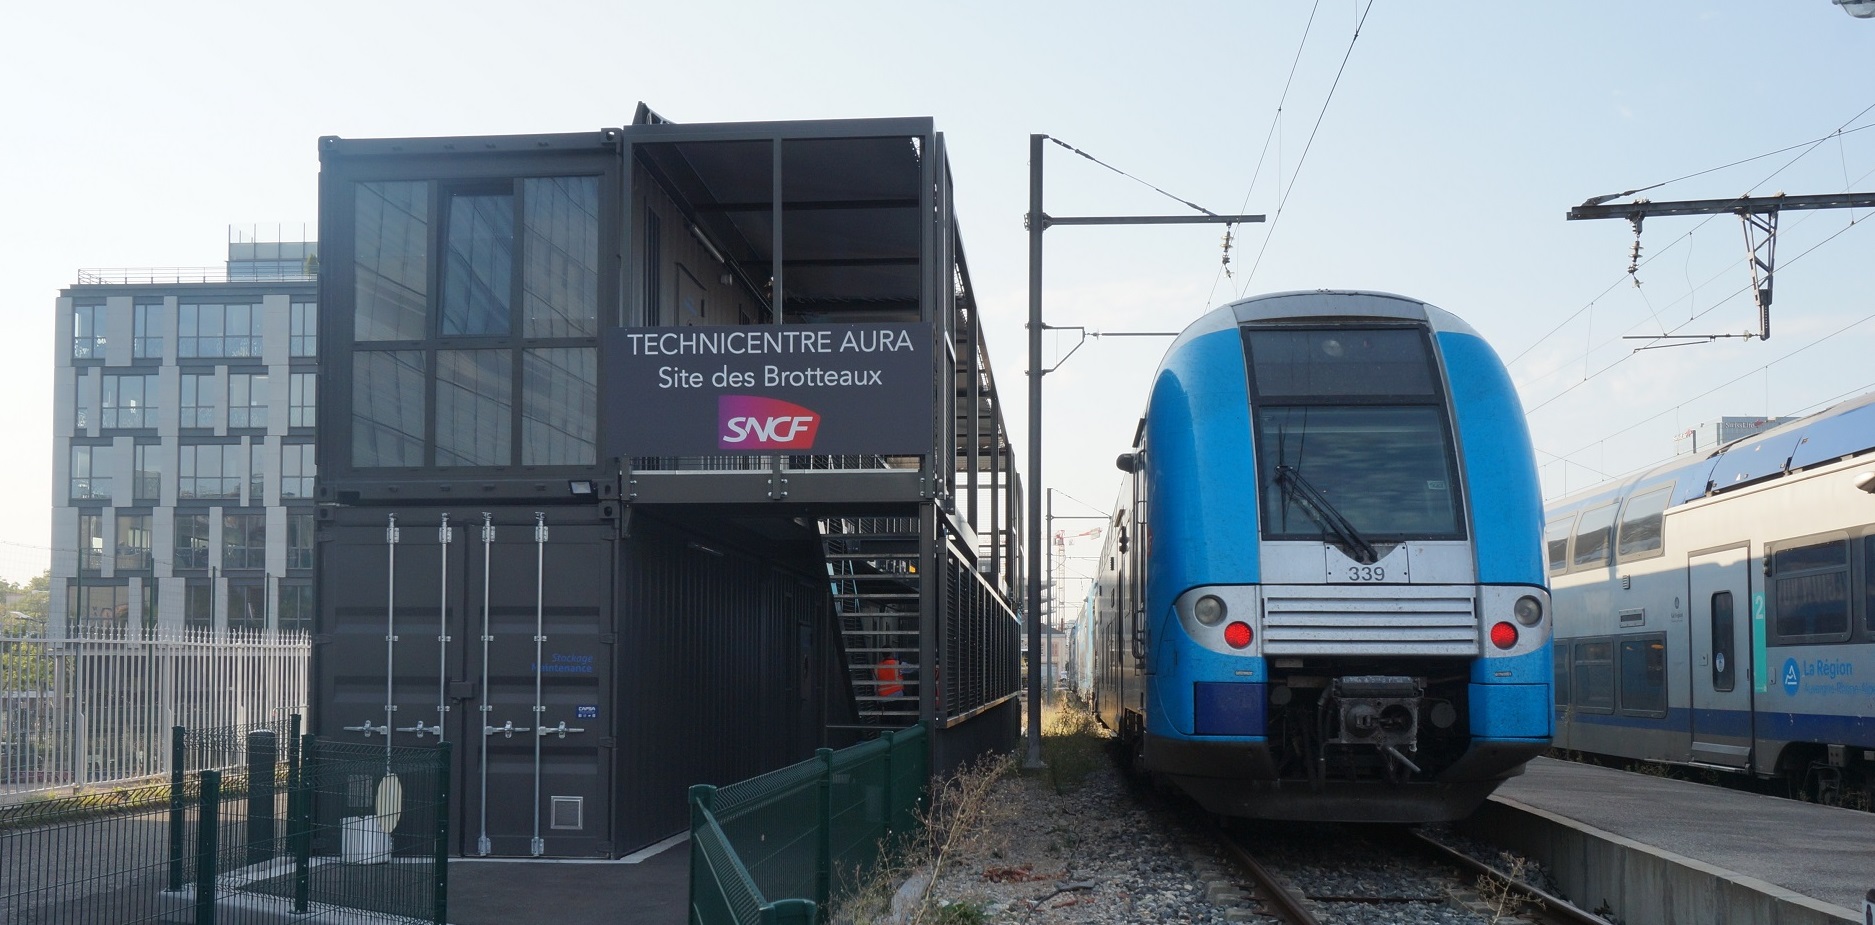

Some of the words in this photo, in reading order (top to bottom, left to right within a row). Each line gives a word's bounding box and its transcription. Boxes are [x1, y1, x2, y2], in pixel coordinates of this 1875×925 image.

[627, 331, 832, 355] TECHNICENTRE
[840, 330, 914, 352] AURA
[658, 366, 703, 388] Site
[711, 365, 755, 388] des
[764, 365, 883, 387] Brotteaux
[722, 416, 813, 442] SNCF
[1348, 566, 1385, 581] 339
[1755, 595, 1764, 619] 2
[552, 653, 593, 664] Stockage
[1803, 660, 1815, 676] La
[1817, 658, 1853, 679] Région
